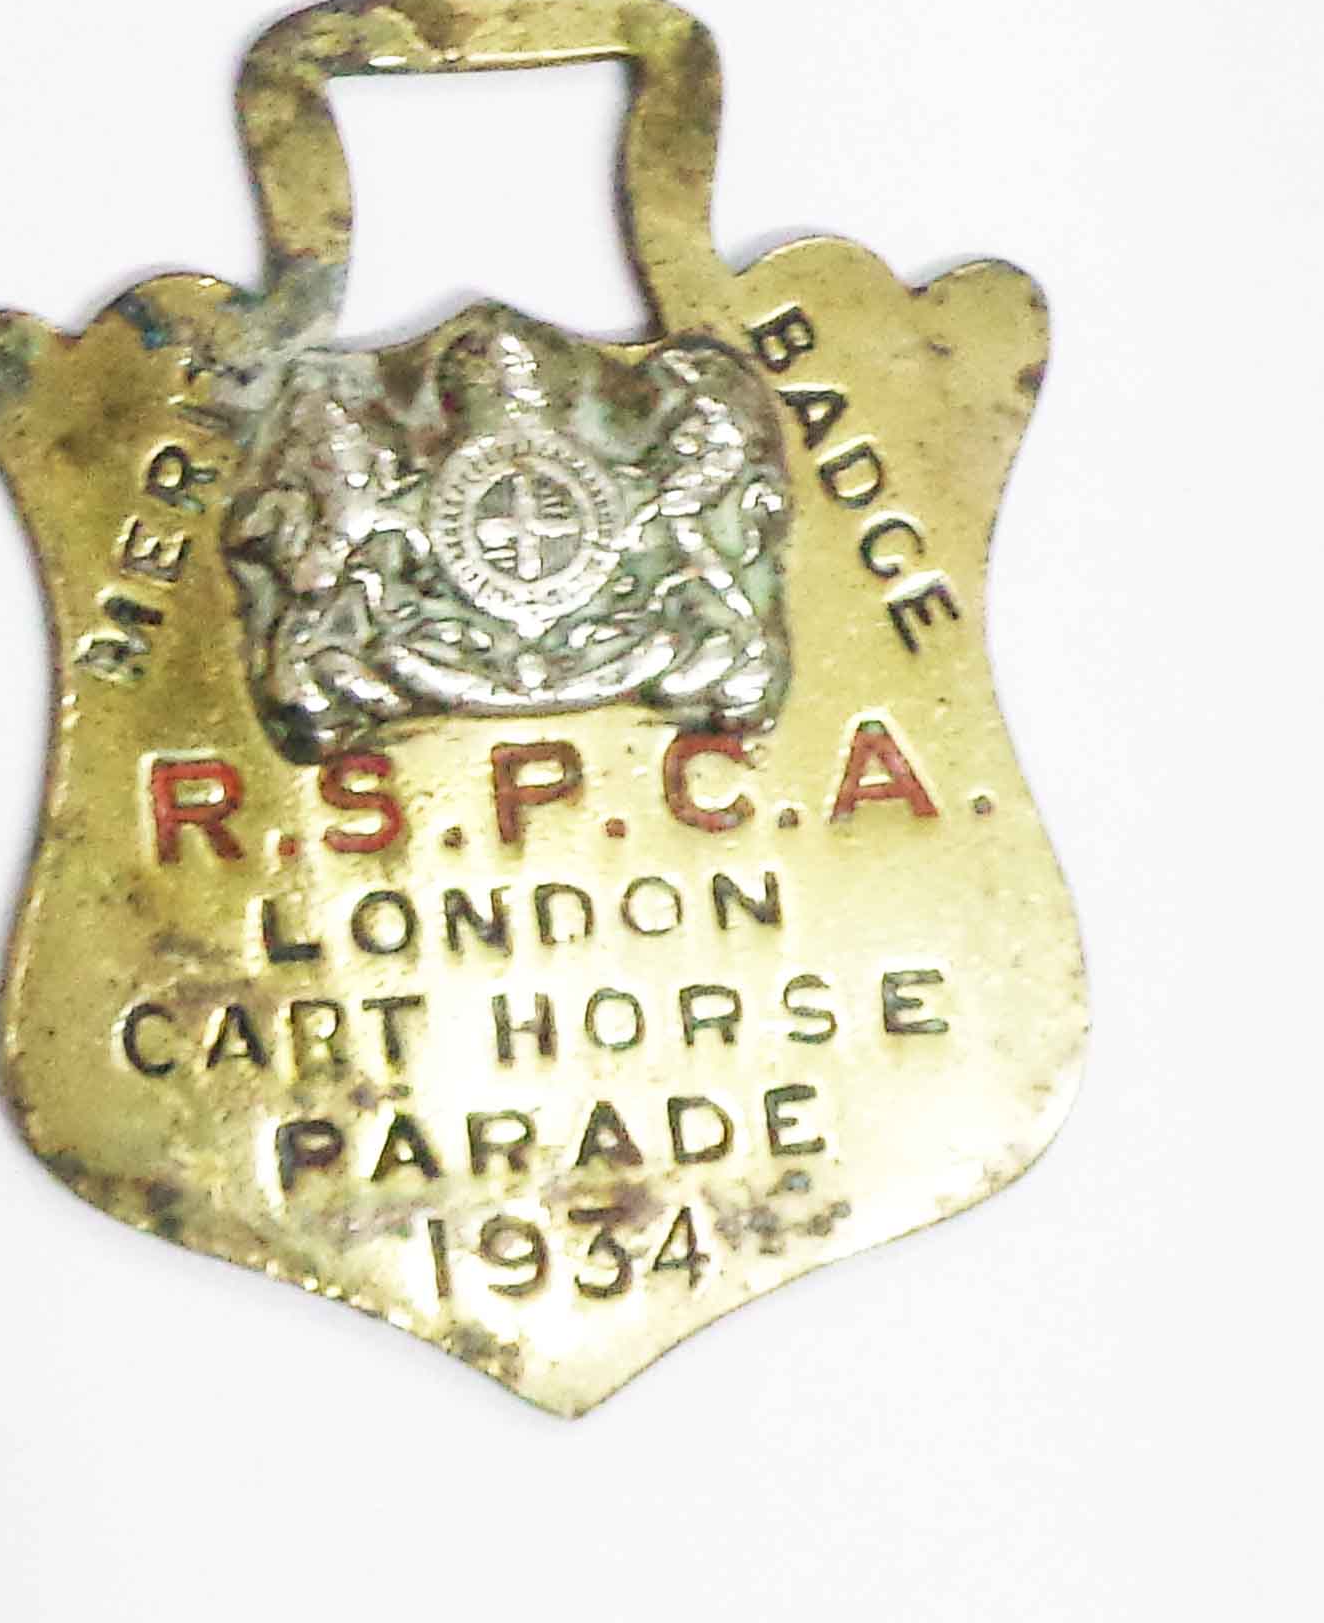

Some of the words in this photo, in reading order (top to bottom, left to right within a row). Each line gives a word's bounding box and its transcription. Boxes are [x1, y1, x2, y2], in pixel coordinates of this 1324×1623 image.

[75, 344, 256, 681] MERIT
[753, 304, 960, 656] BADGE
[147, 715, 994, 868] R.S.P.C.A.
[262, 868, 784, 966] LONDON
[121, 990, 426, 1078] CART
[492, 966, 948, 1071] HORSE
[275, 1083, 828, 1190] PARADE
[426, 1203, 710, 1305] 1934
